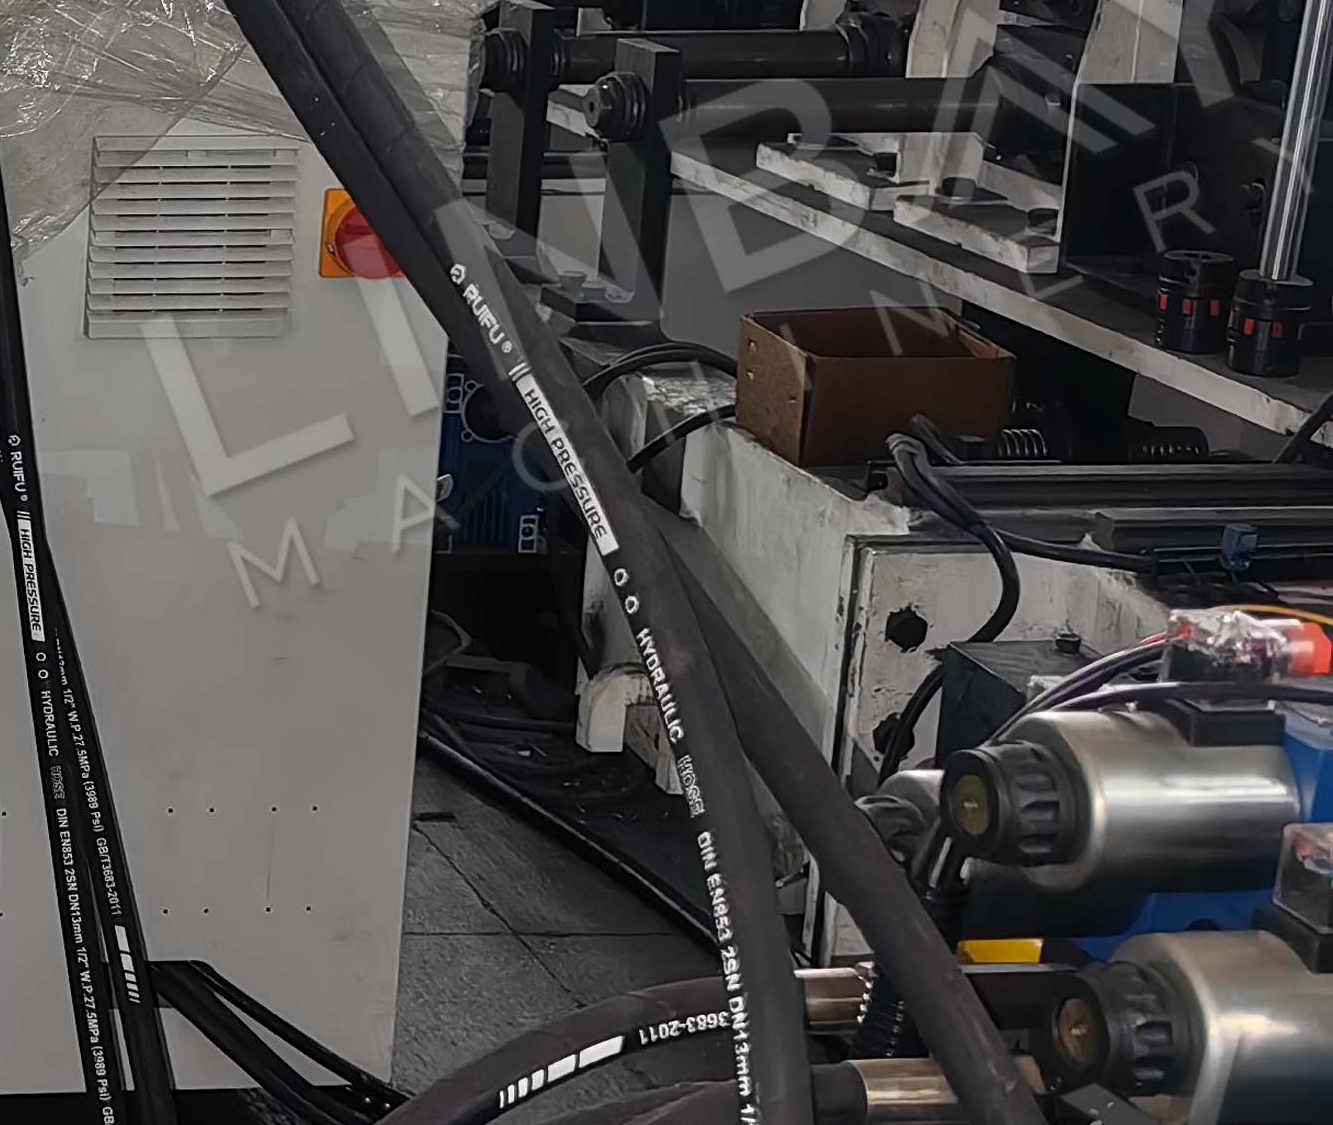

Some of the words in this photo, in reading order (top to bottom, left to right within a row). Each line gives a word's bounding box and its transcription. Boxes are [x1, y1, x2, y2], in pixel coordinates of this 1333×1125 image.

[524, 389, 553, 434] HIGH
[552, 437, 608, 540] PRESSURE
[20, 528, 33, 559] HIGH
[24, 563, 42, 632] PRESSURE
[636, 627, 684, 744] HYDRAULIC
[41, 690, 59, 757] HYDRAULIC
[57, 807, 68, 829] DIN
[60, 830, 75, 866] EN853
[83, 780, 99, 810] (3989
[97, 837, 122, 916] GB/T3683-2011
[697, 831, 718, 870] DIN
[64, 863, 79, 891] 2SN
[68, 894, 84, 944] DN13mm
[706, 873, 733, 943] EN853
[720, 946, 740, 991] 2SN
[91, 1045, 107, 1078] (3989
[728, 995, 751, 1096] DN13mm
